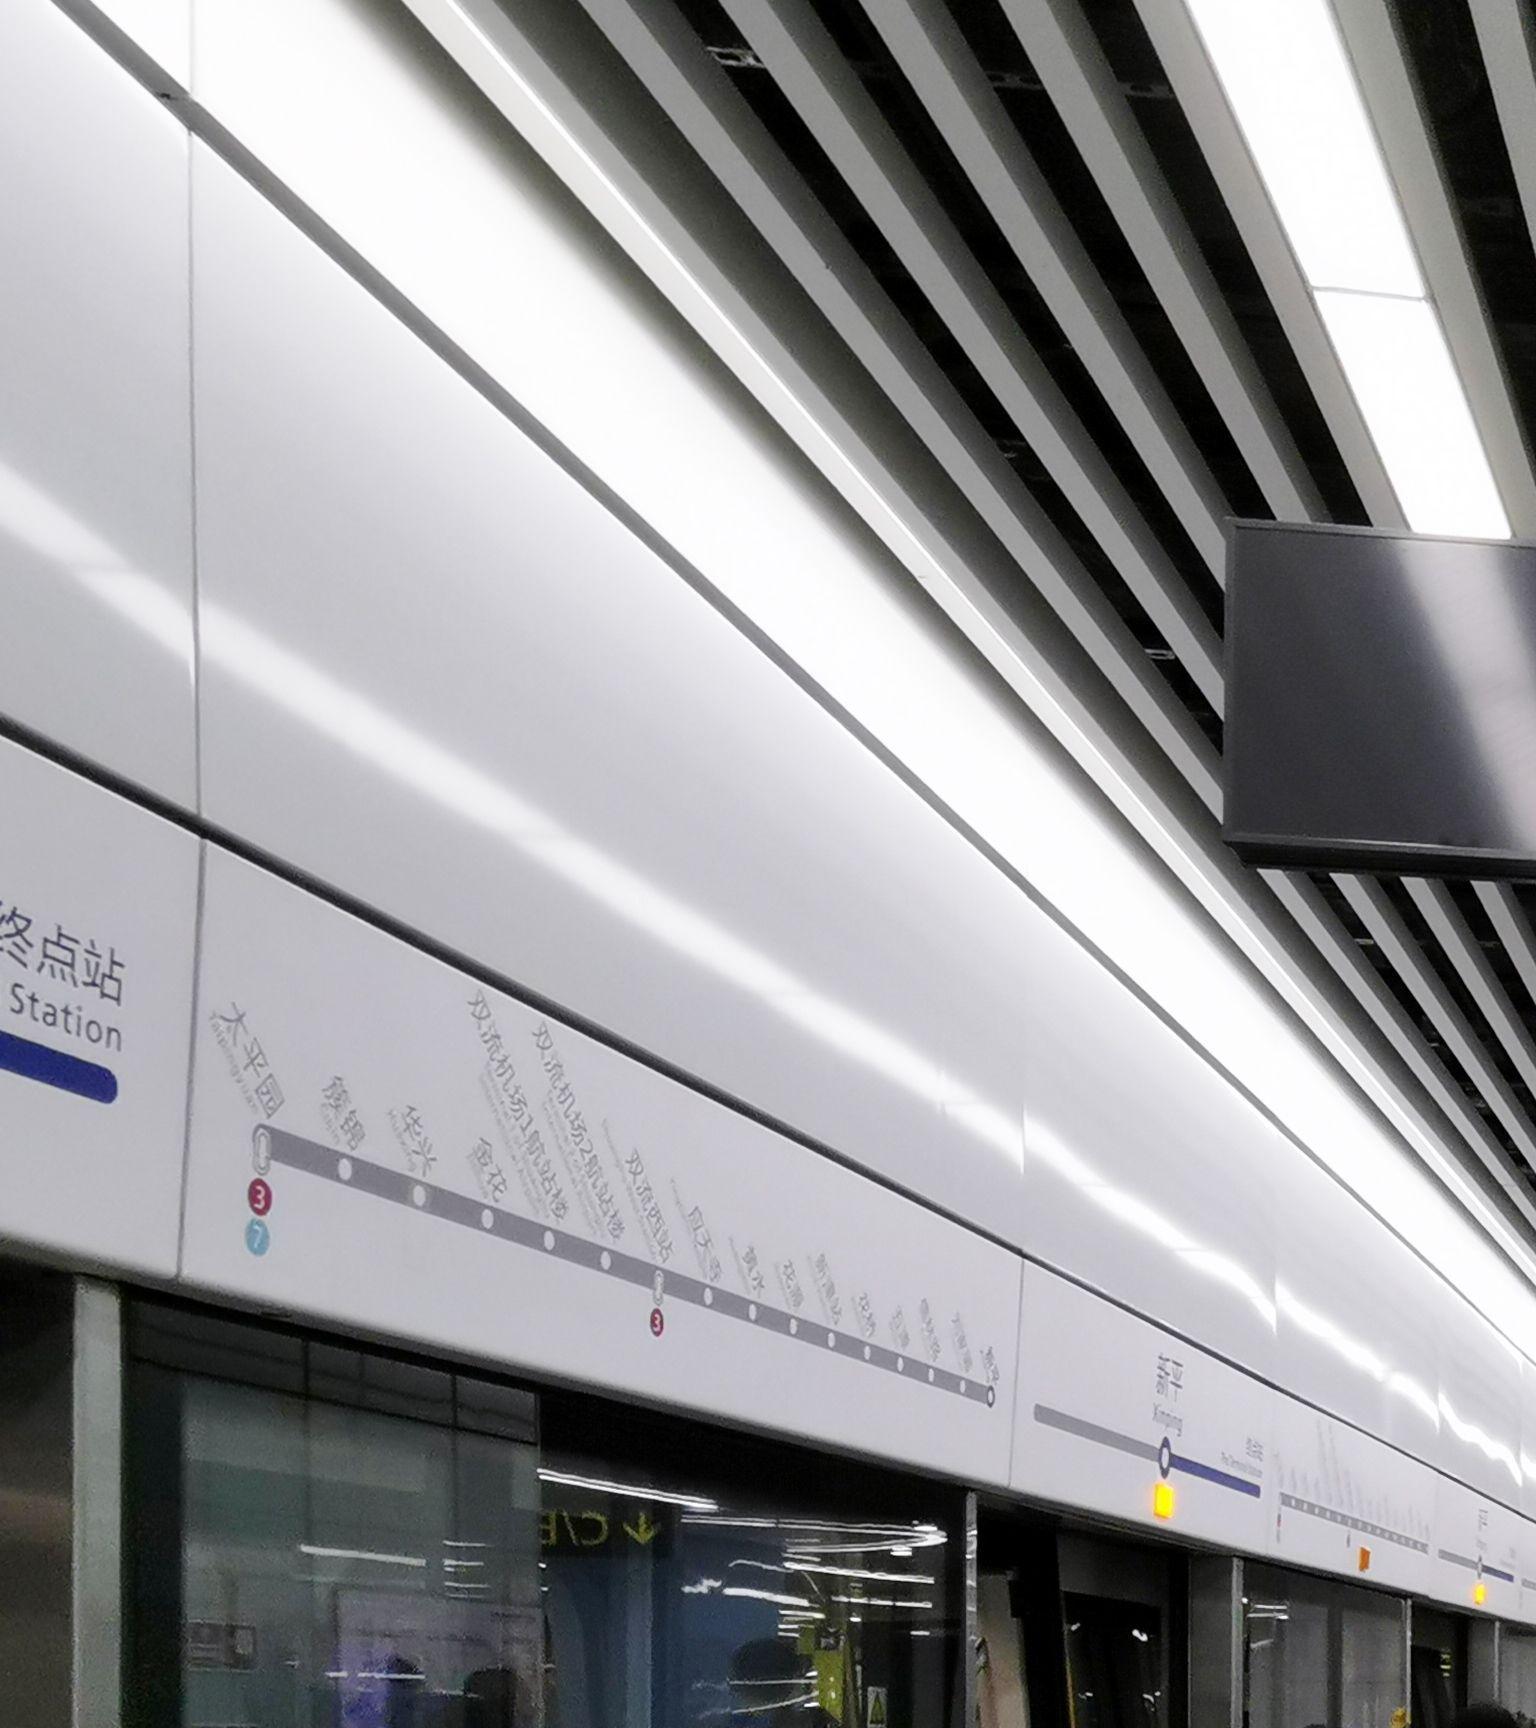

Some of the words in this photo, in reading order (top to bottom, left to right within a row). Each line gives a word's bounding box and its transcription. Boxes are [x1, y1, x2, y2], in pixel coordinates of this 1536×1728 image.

[9, 982, 122, 1053] Station
[220, 1001, 286, 1120] 太平园
[402, 1104, 438, 1179] 华兴
